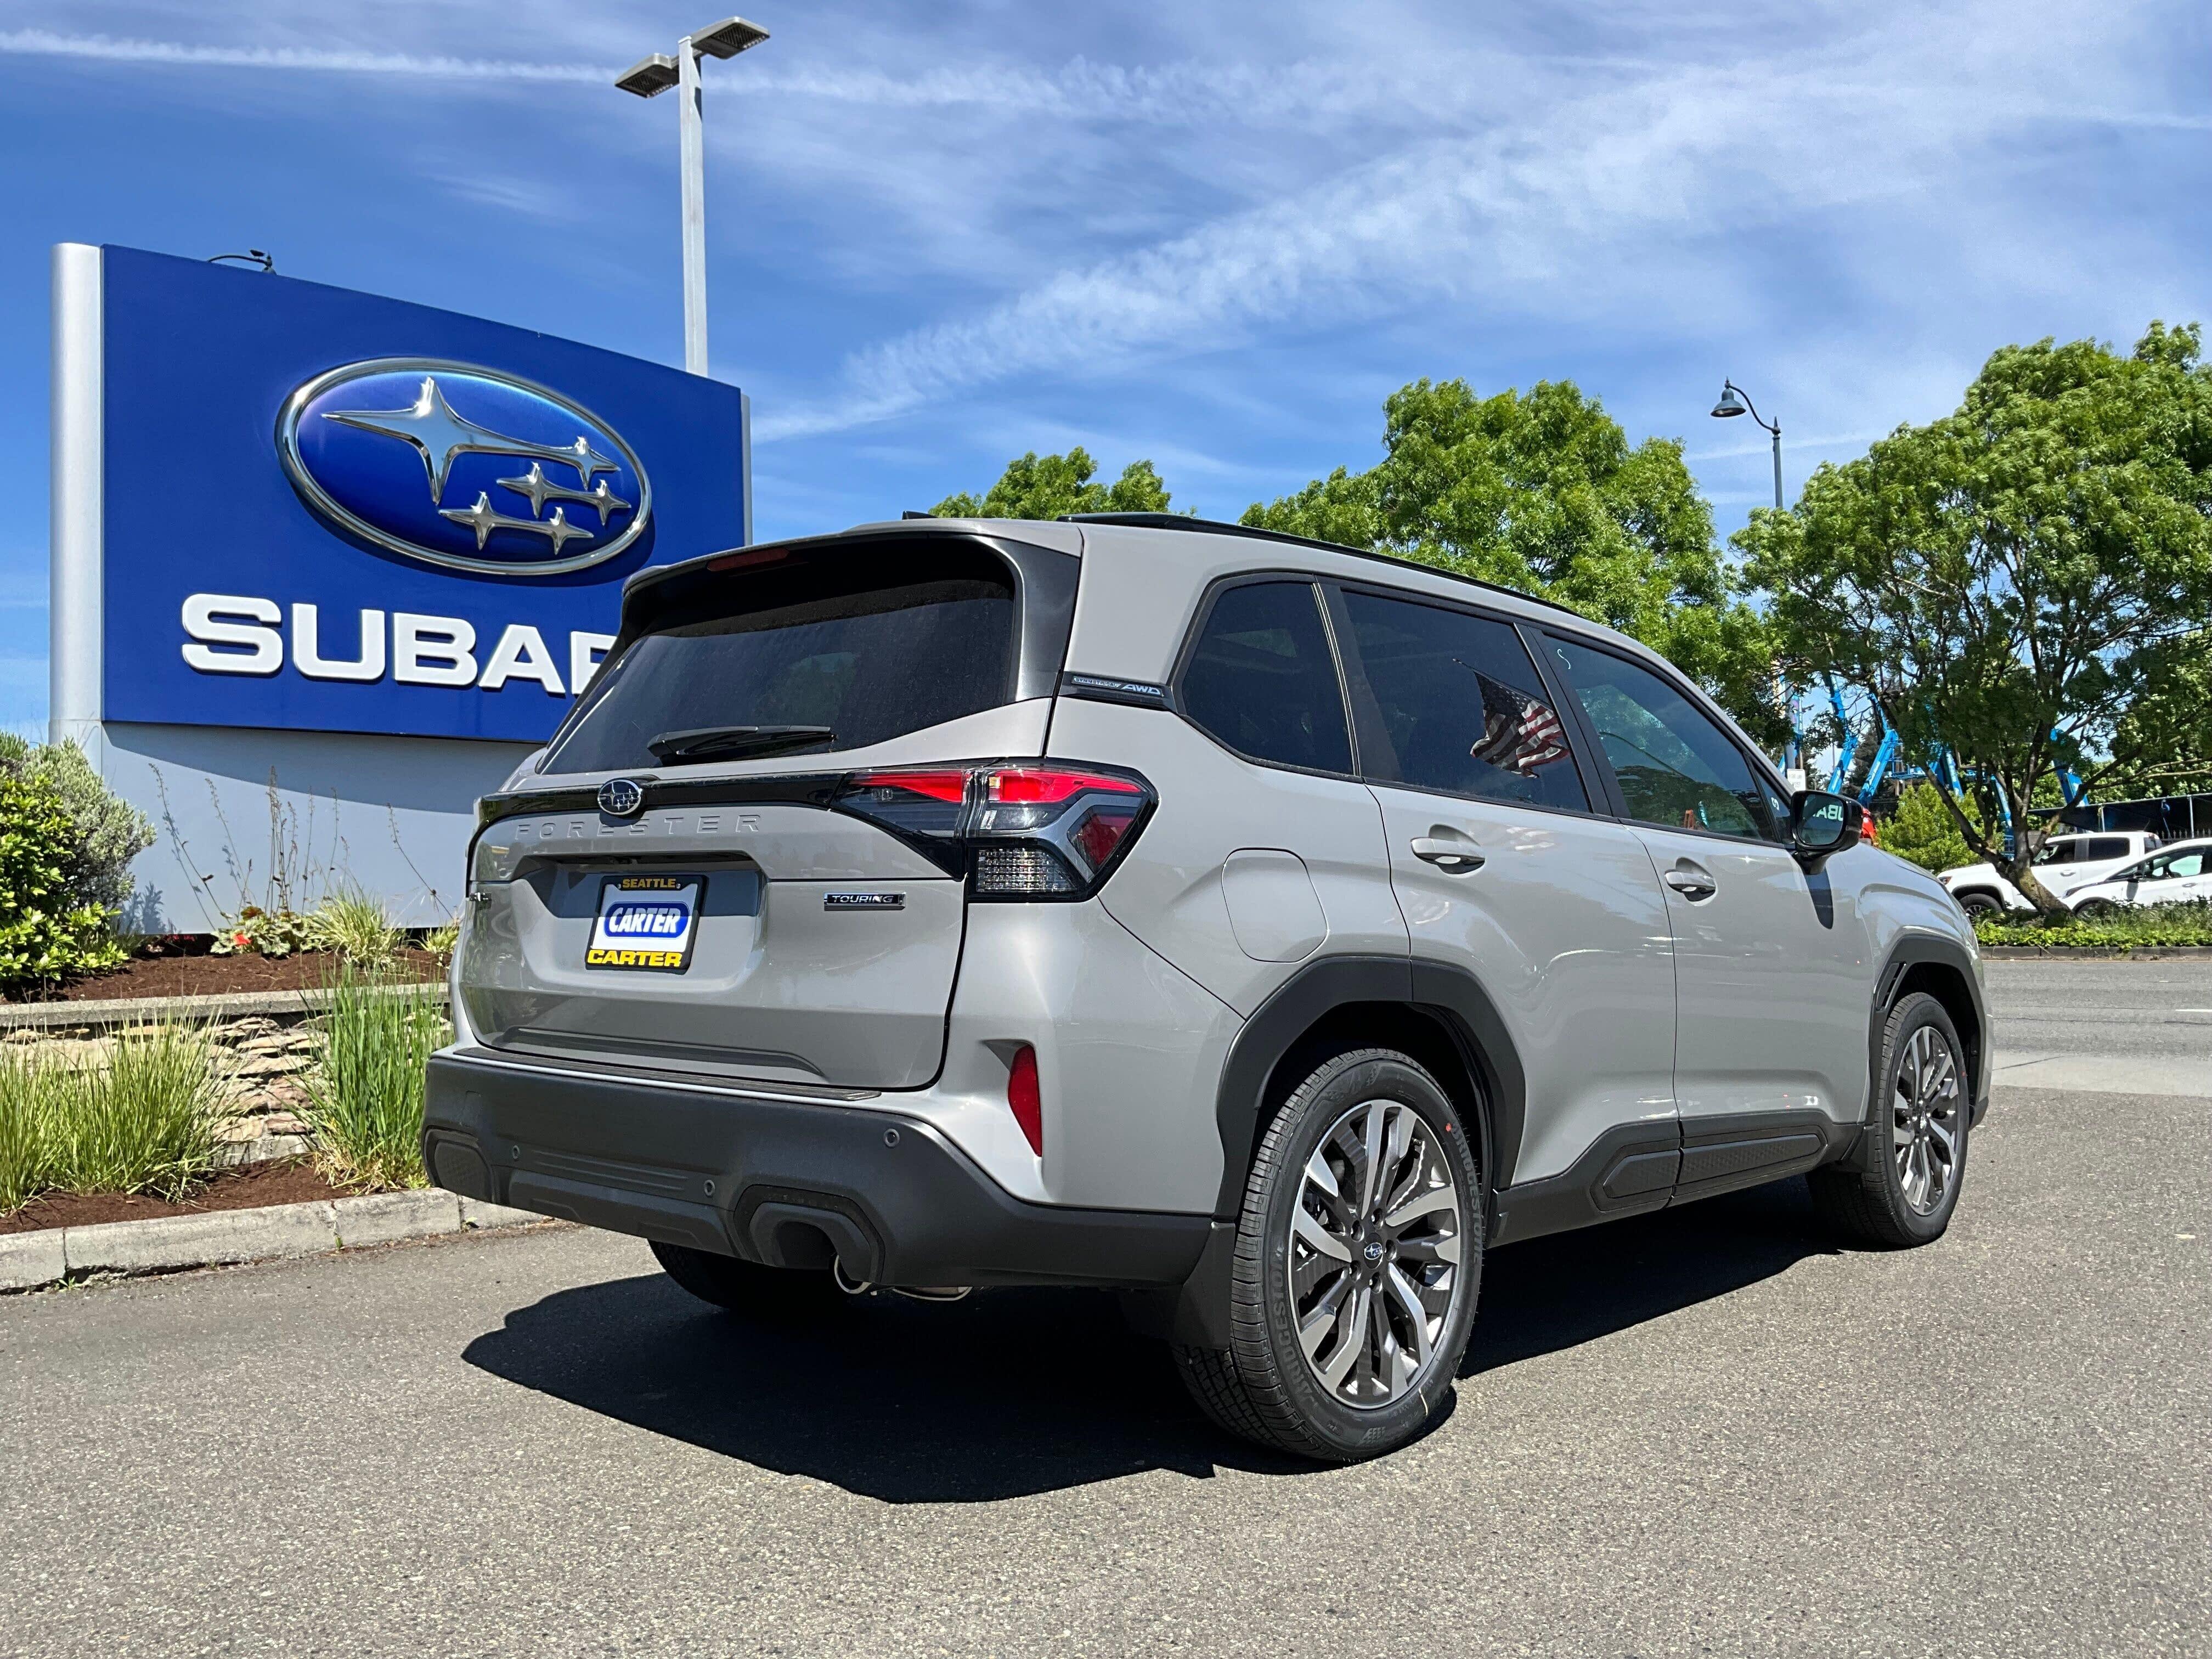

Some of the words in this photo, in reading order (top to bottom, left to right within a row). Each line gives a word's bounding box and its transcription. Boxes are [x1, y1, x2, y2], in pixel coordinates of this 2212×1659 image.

[1121, 683, 1161, 696] AWD
[515, 814, 761, 840] FORESTER
[622, 878, 676, 889] SEATTLE
[832, 895, 894, 903] TOURING
[608, 907, 681, 933] CARTER
[587, 949, 682, 967] CARTER
